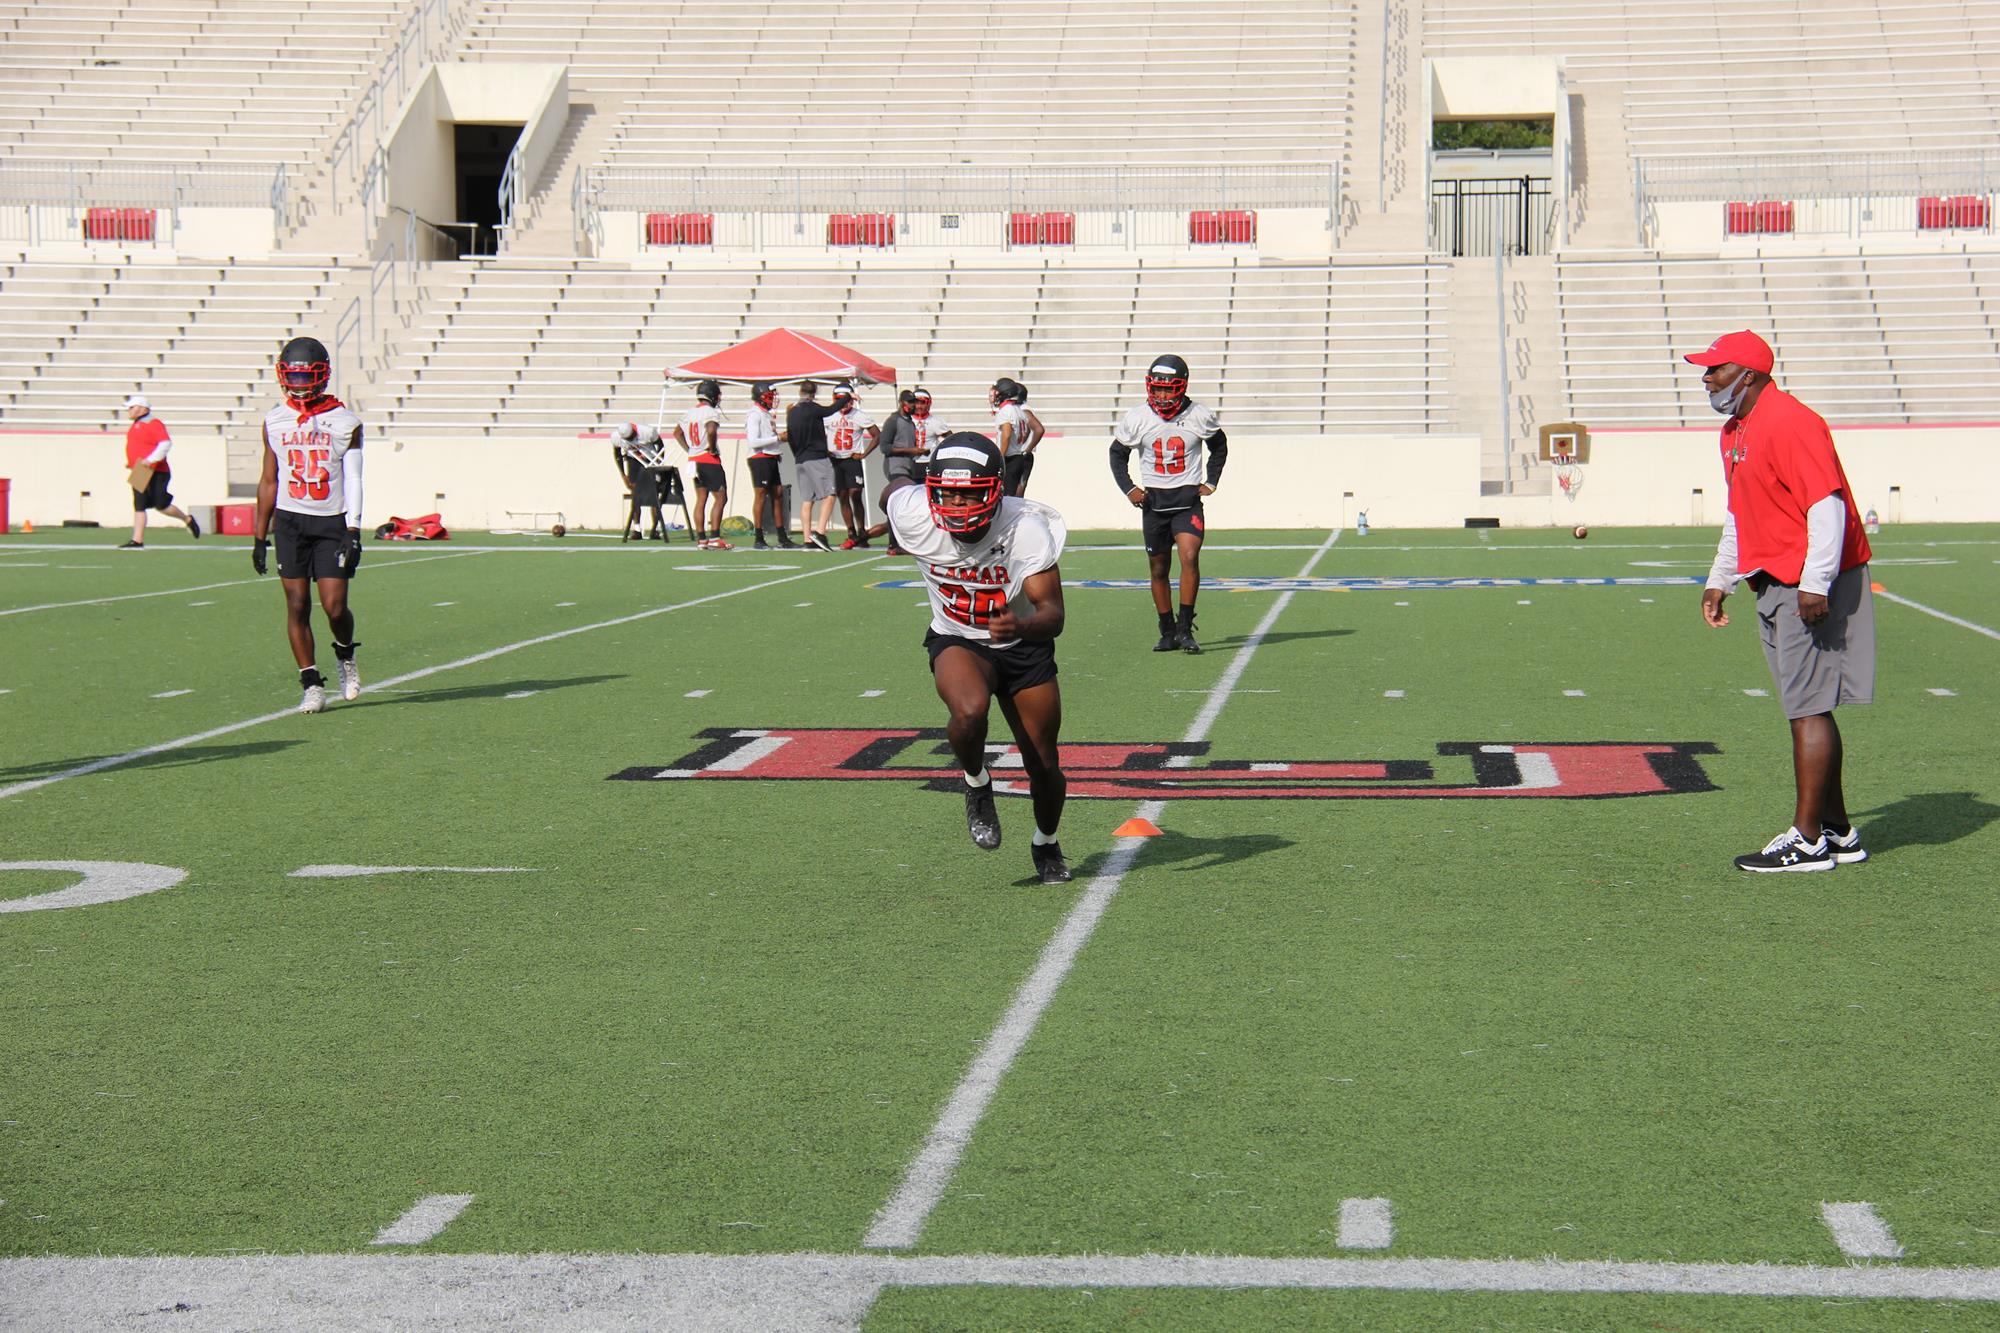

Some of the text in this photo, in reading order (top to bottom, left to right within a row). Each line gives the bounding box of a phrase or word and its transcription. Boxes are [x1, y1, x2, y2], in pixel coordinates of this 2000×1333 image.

[281, 431, 333, 446] LAMAR
[834, 428, 853, 450] 45
[1151, 436, 1186, 475] 13
[287, 449, 331, 501] 35
[930, 563, 1012, 585] LAMAR
